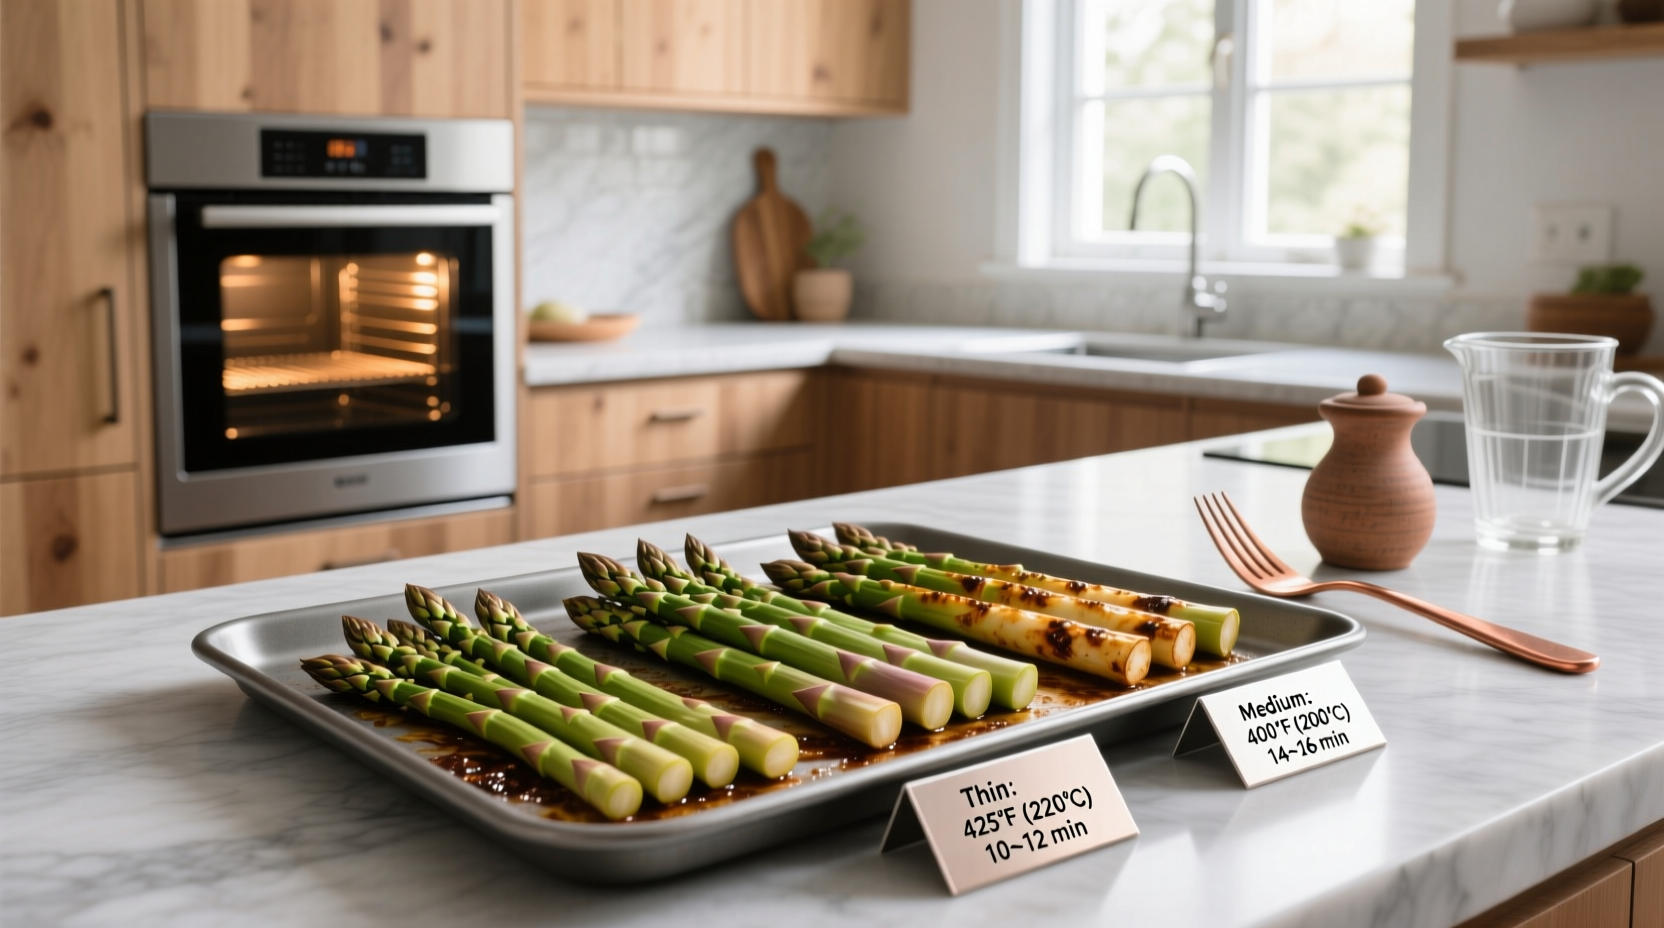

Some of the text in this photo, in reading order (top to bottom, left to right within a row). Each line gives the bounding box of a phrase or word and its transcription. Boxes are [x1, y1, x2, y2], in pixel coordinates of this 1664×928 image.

[1238, 692, 1313, 722] Medium:
[1318, 730, 1350, 751] min
[959, 780, 1017, 808] Thin:
[964, 786, 1093, 839] 425°F (220°C)
[1050, 819, 1088, 845] min
